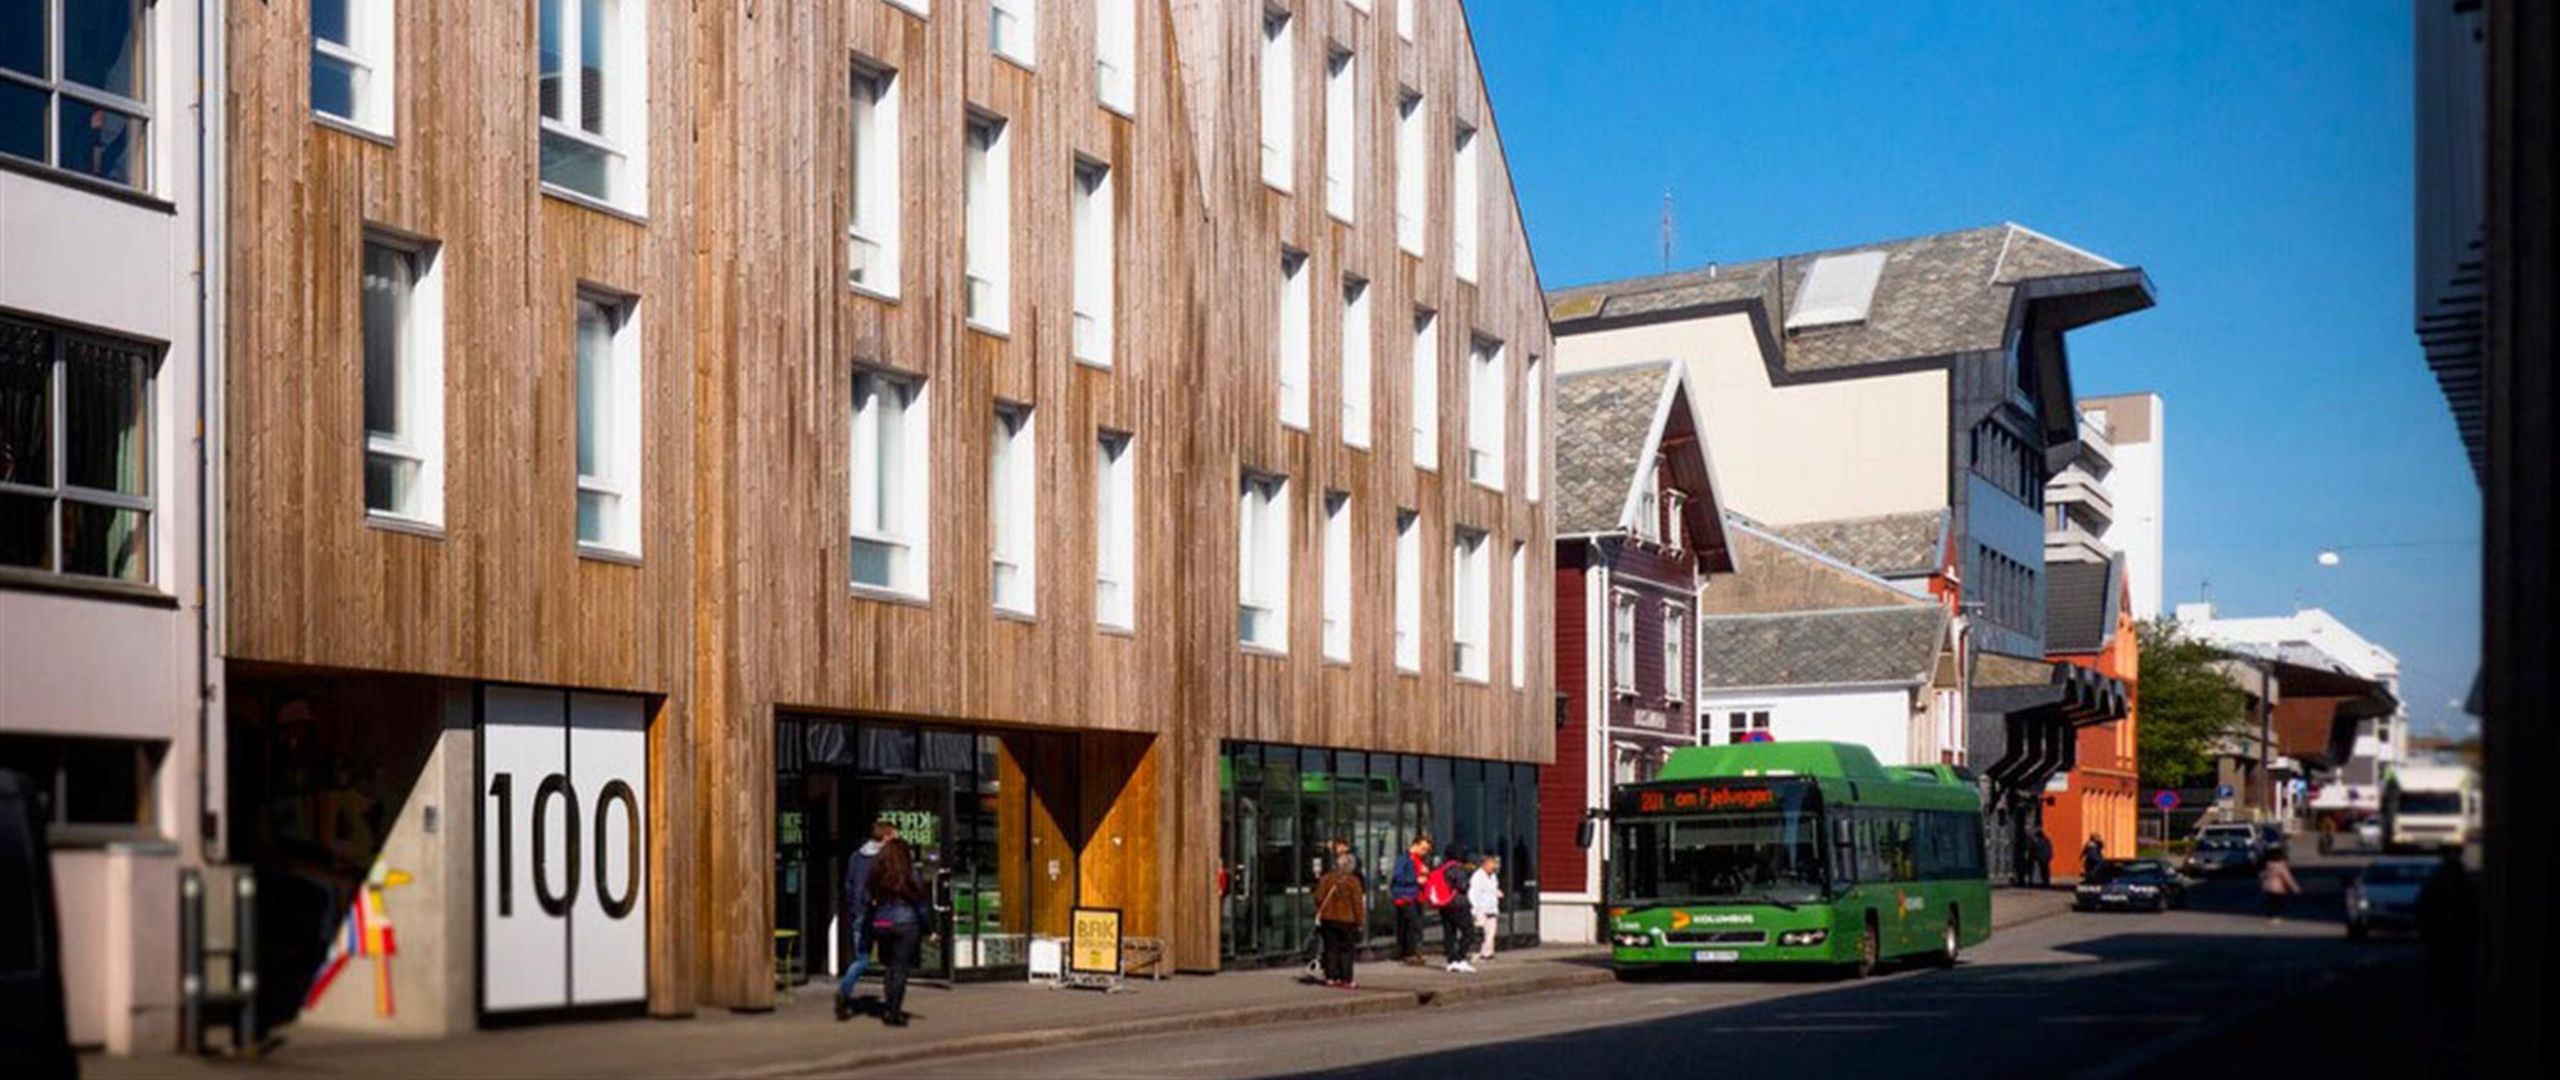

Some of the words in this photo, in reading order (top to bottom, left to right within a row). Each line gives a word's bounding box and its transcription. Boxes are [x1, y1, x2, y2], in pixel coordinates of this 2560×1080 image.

[489, 773, 640, 919] 100
[1693, 914, 1754, 924] KOLUMBUS
[1078, 920, 1115, 939] BAK
